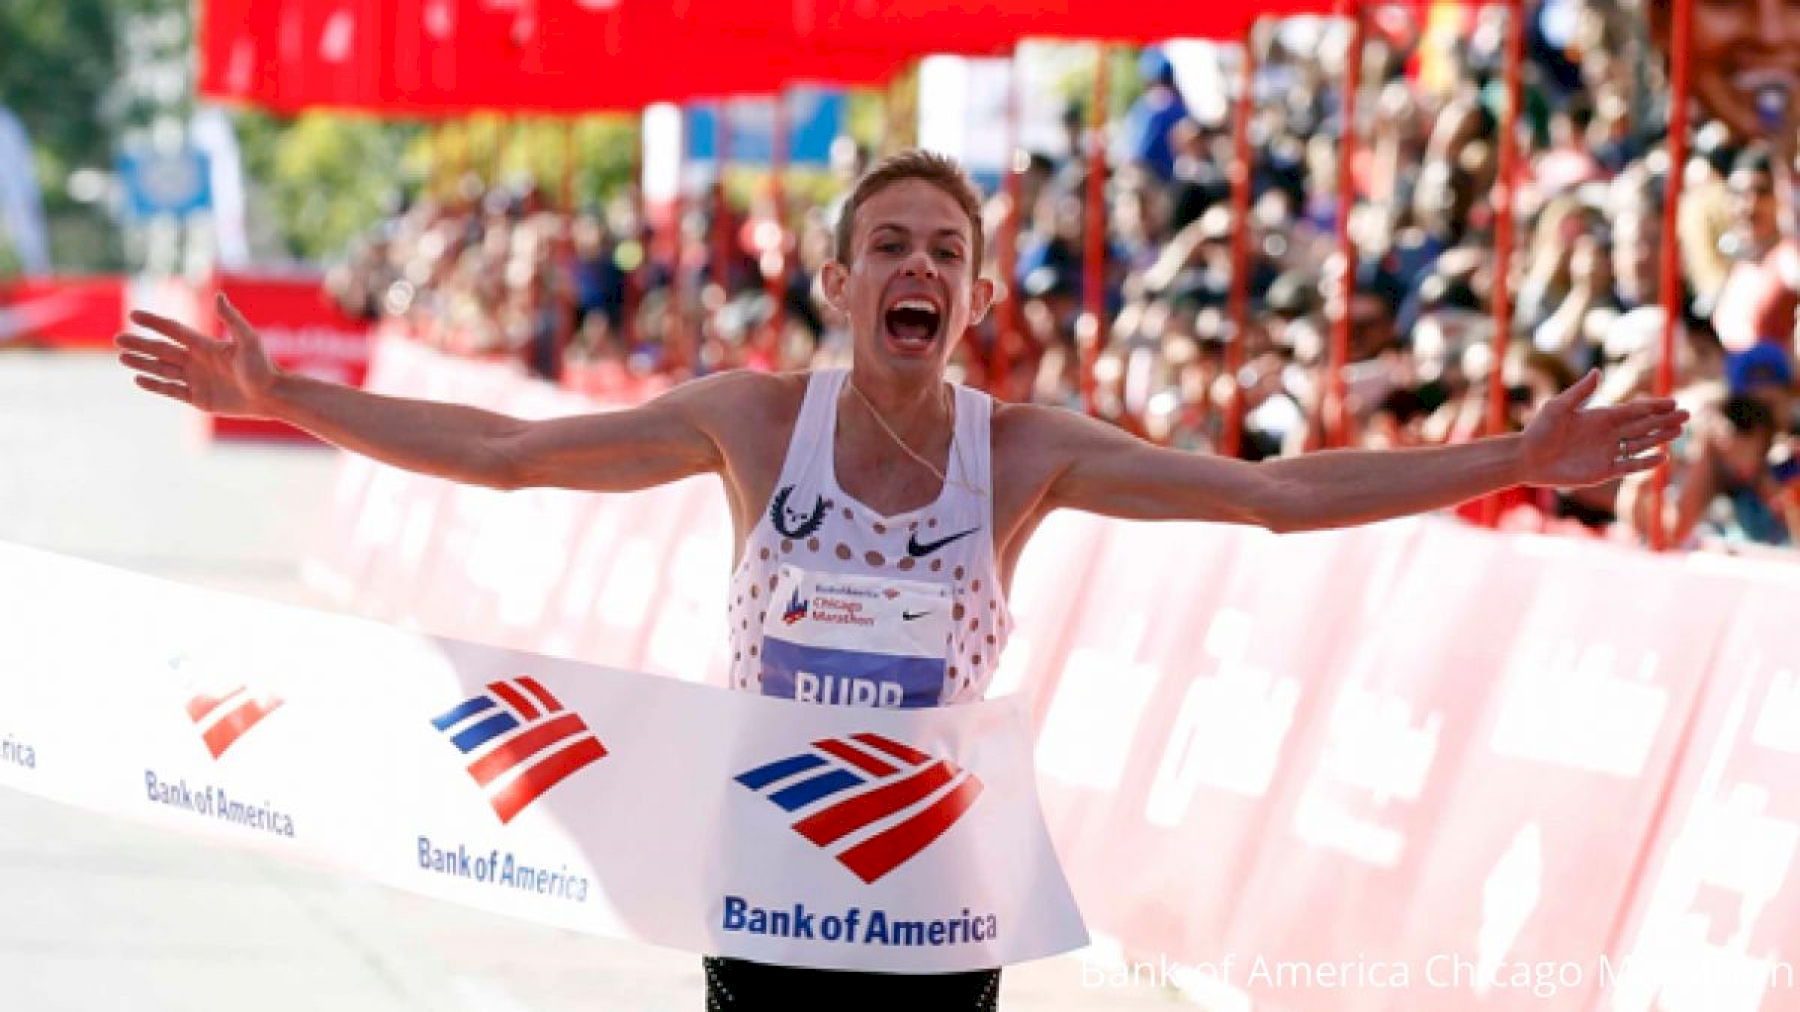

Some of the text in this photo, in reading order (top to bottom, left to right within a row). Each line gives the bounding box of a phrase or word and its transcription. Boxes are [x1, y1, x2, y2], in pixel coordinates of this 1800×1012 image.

[813, 597, 863, 612] Chicago
[813, 611, 875, 627] Marathon
[145, 769, 295, 838] Bank of America
[418, 835, 588, 902] Bank of America
[722, 895, 997, 946] Bank of America
